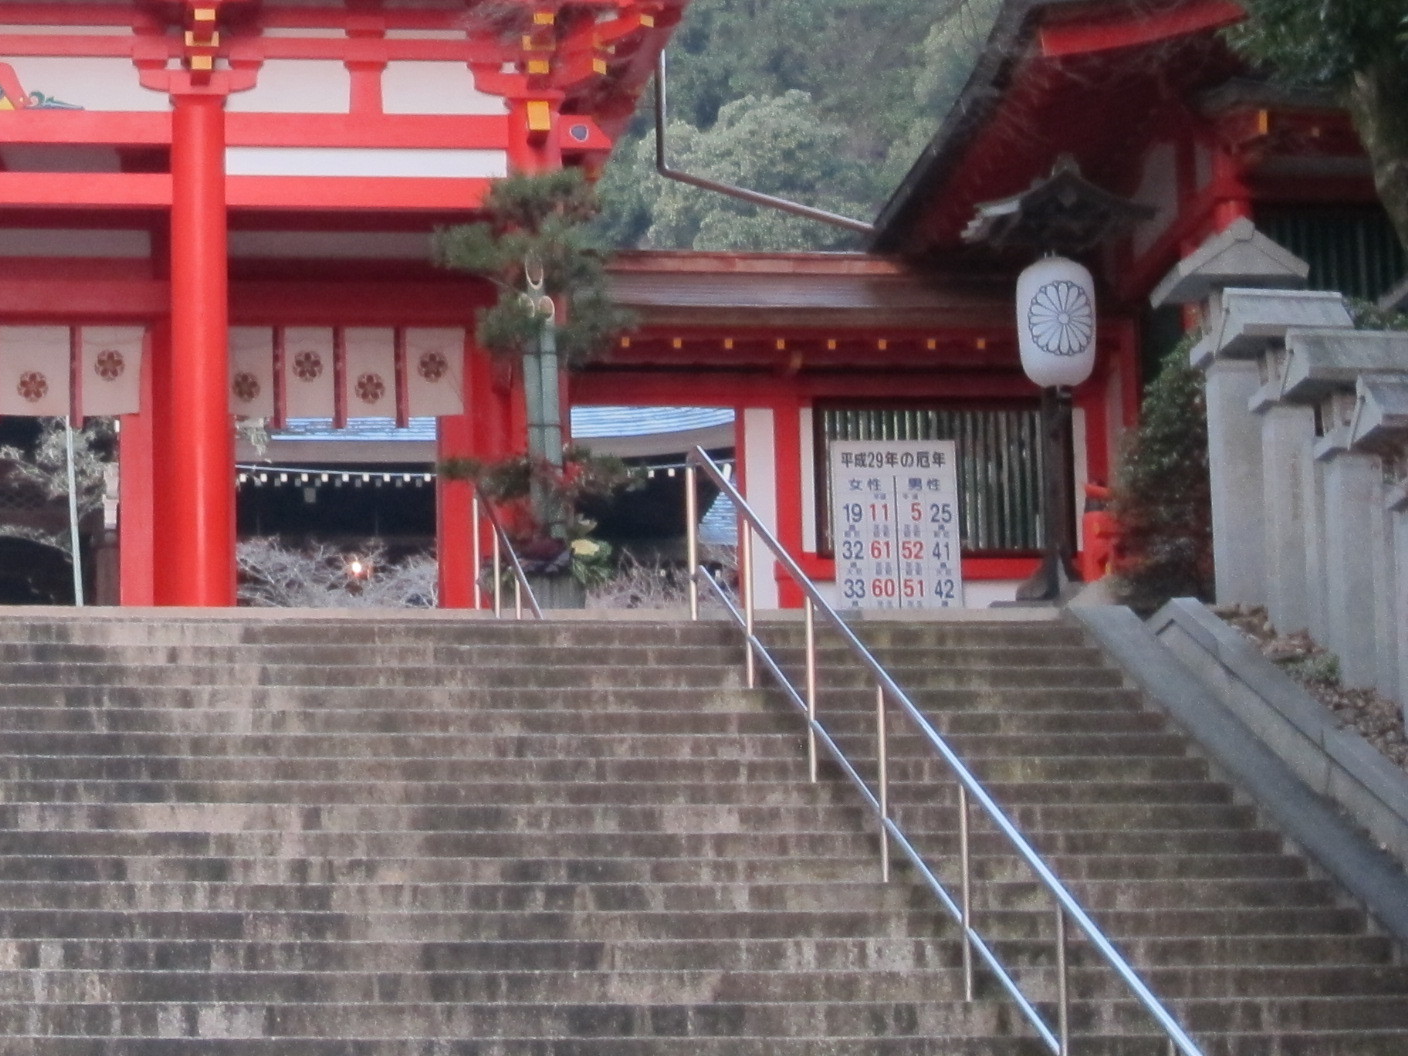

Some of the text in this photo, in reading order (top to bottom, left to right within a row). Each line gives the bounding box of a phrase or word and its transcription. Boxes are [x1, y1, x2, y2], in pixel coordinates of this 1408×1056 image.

[841, 451, 946, 468] 平成29年の厄年
[848, 478, 881, 491] 女性
[908, 477, 941, 491] 男性
[843, 503, 889, 523] 19 11
[911, 502, 952, 523] 5 25
[842, 540, 890, 560] 32 61
[902, 541, 950, 560] 52 41
[844, 578, 895, 598] 33 60
[903, 579, 955, 598] 51 42
